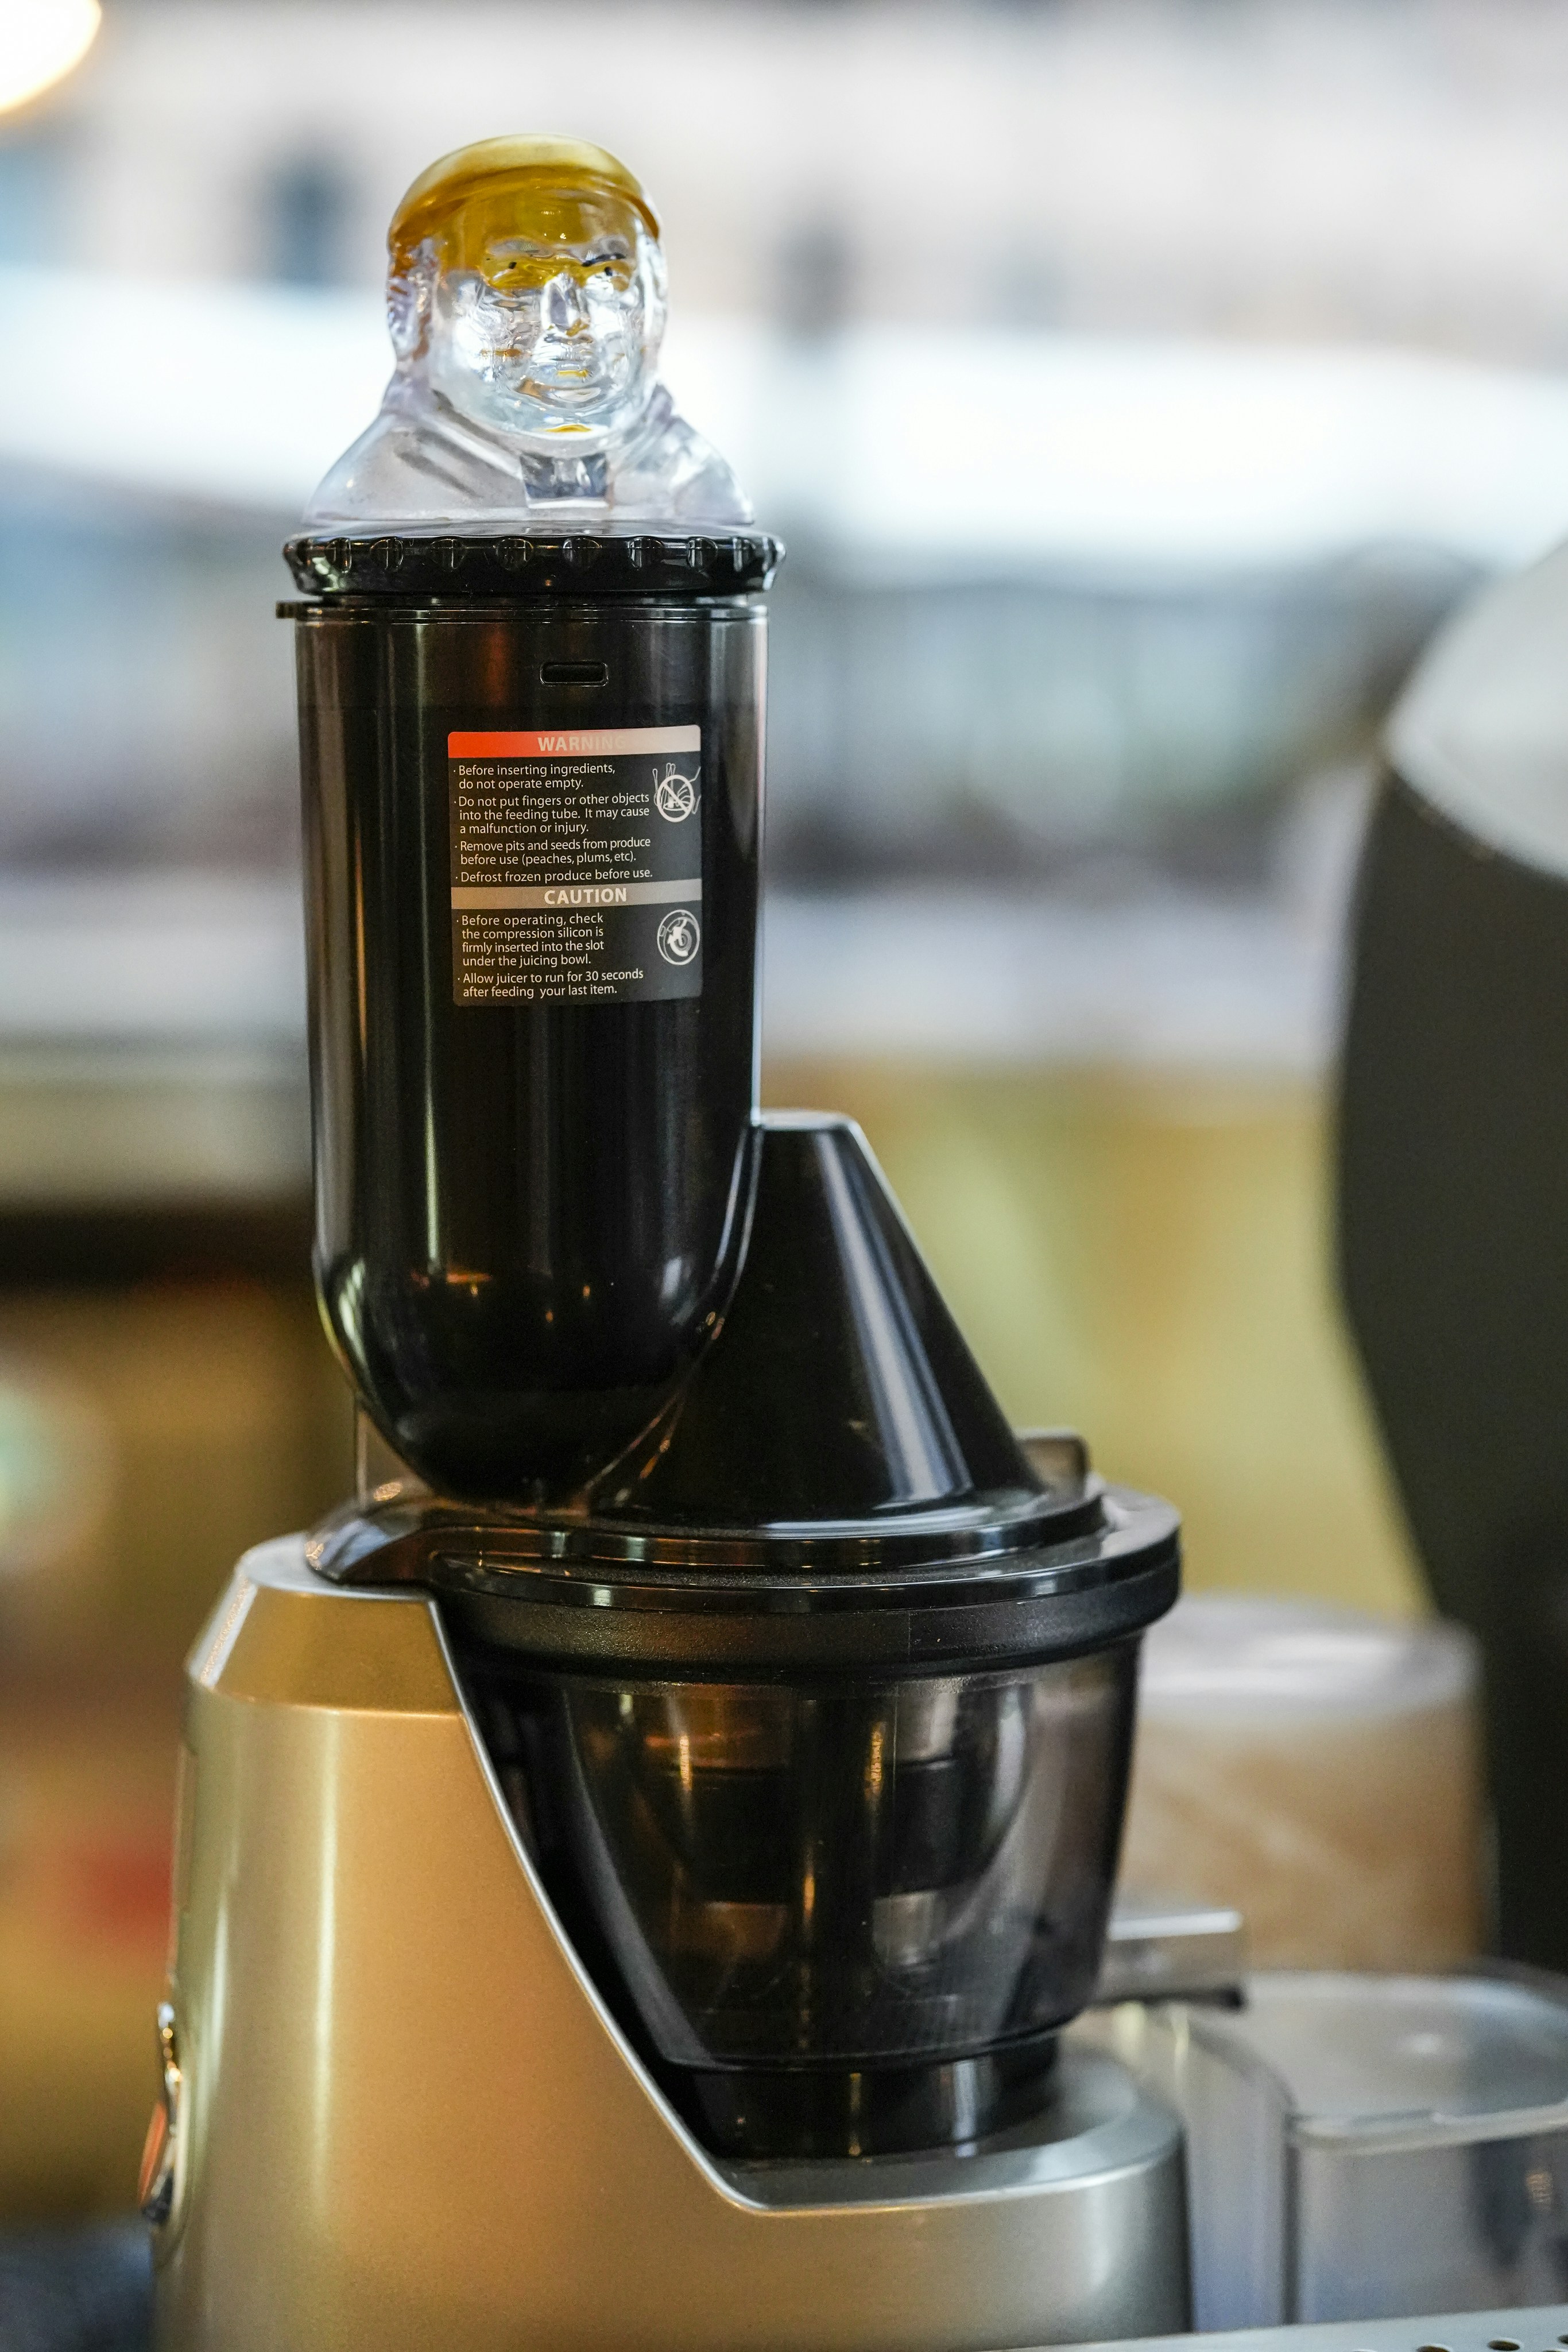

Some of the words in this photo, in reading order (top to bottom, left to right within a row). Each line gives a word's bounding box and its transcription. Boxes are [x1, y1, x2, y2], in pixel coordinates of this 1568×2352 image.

[537, 735, 626, 752] WARNING
[459, 764, 494, 776] Before
[497, 764, 547, 777] inserting
[550, 763, 615, 777] ingredients,
[459, 778, 474, 790] do
[477, 780, 495, 789] not
[499, 779, 542, 791] operate
[545, 778, 583, 791] empty.
[459, 796, 474, 807] Do
[478, 797, 497, 807] not
[500, 797, 520, 809] put
[522, 795, 562, 808] fingers
[564, 797, 576, 805] or
[579, 794, 609, 805] other
[611, 792, 649, 806] objects
[459, 810, 481, 820] into
[483, 809, 502, 820] the
[505, 808, 548, 822] feeding
[551, 808, 580, 819] tube.
[585, 808, 593, 818] It
[595, 809, 618, 820] may
[620, 807, 650, 817] cause
[460, 826, 466, 834] a
[469, 822, 537, 834] malfunction
[540, 825, 552, 833] or
[555, 822, 589, 835] injury.
[460, 841, 503, 851] Remove
[506, 840, 525, 853] pits
[527, 839, 548, 850] and
[551, 838, 581, 850] seeds
[582, 838, 607, 849] from
[610, 837, 651, 851] produce
[460, 853, 496, 865] before
[500, 856, 518, 865] use
[522, 853, 575, 867] (peaches,
[576, 852, 613, 865] plums,
[614, 850, 636, 862] etc).
[461, 871, 502, 882] Defrost
[505, 871, 541, 882] frozen
[545, 869, 592, 884] produce
[595, 868, 630, 880] before
[633, 869, 653, 878] use.
[544, 887, 627, 906] CAUTION
[462, 915, 500, 926] Before
[504, 914, 566, 929] operating,
[569, 912, 603, 924] check
[462, 929, 480, 939] the
[483, 929, 555, 941] compression
[557, 926, 593, 938] silicon
[595, 926, 603, 937] is
[462, 941, 493, 956] firmly
[495, 941, 539, 953] inserted
[541, 941, 563, 951] into
[564, 940, 583, 951] the
[585, 939, 605, 950] slot
[463, 956, 495, 966] under
[498, 955, 517, 966] the
[518, 955, 557, 969] juicing
[561, 953, 591, 965] bowl.
[463, 972, 494, 984] Allow
[495, 973, 528, 986] juicer
[530, 973, 542, 983] to
[545, 974, 564, 982] run
[567, 970, 583, 982] for
[585, 970, 599, 981] 30
[601, 968, 644, 981] seconds
[463, 986, 489, 997] after
[491, 985, 534, 999] feeding
[539, 988, 566, 999] your
[568, 984, 588, 995] last
[590, 984, 617, 995] item.
